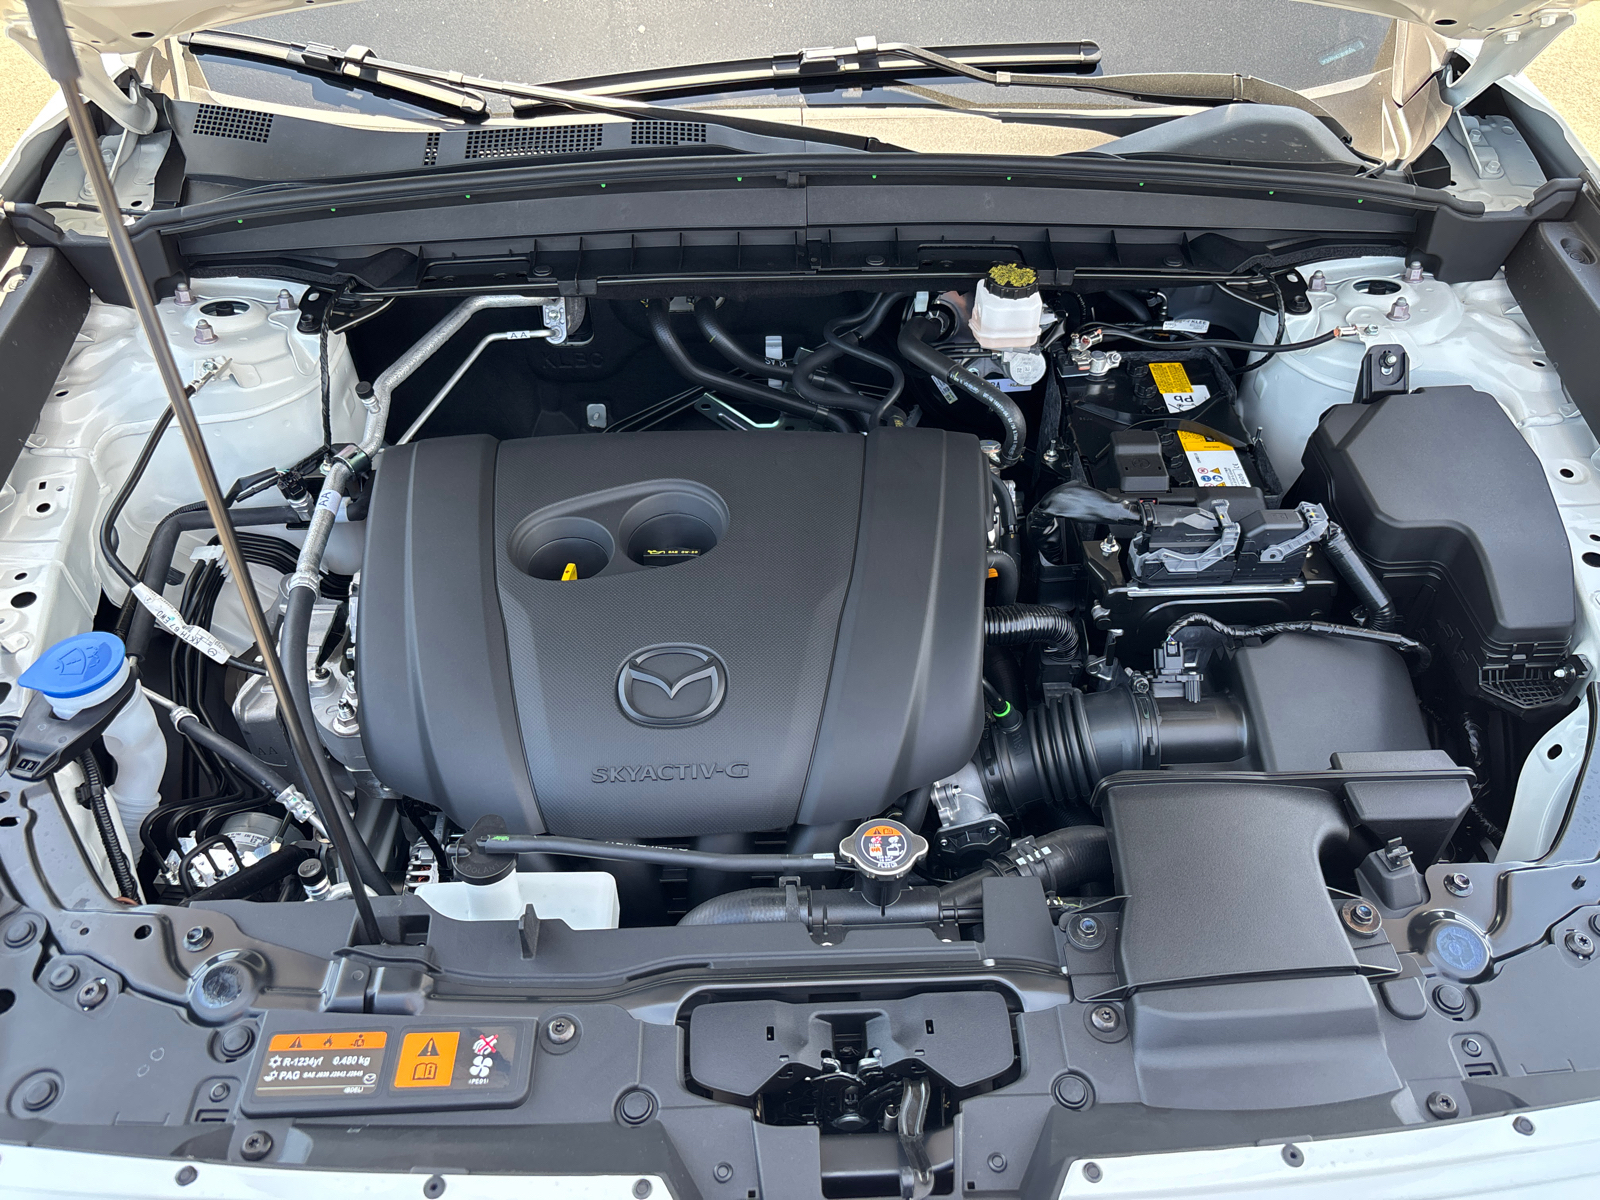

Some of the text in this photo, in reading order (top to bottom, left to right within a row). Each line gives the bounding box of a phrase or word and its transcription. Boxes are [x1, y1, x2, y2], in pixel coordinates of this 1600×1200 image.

[1173, 395, 1195, 403] Pb
[591, 762, 750, 784] SKYACTIV-G
[460, 860, 503, 874] COOLANT
[282, 1056, 324, 1068] R-1234yf
[358, 1056, 371, 1066] kg
[278, 1070, 301, 1080] PAG
